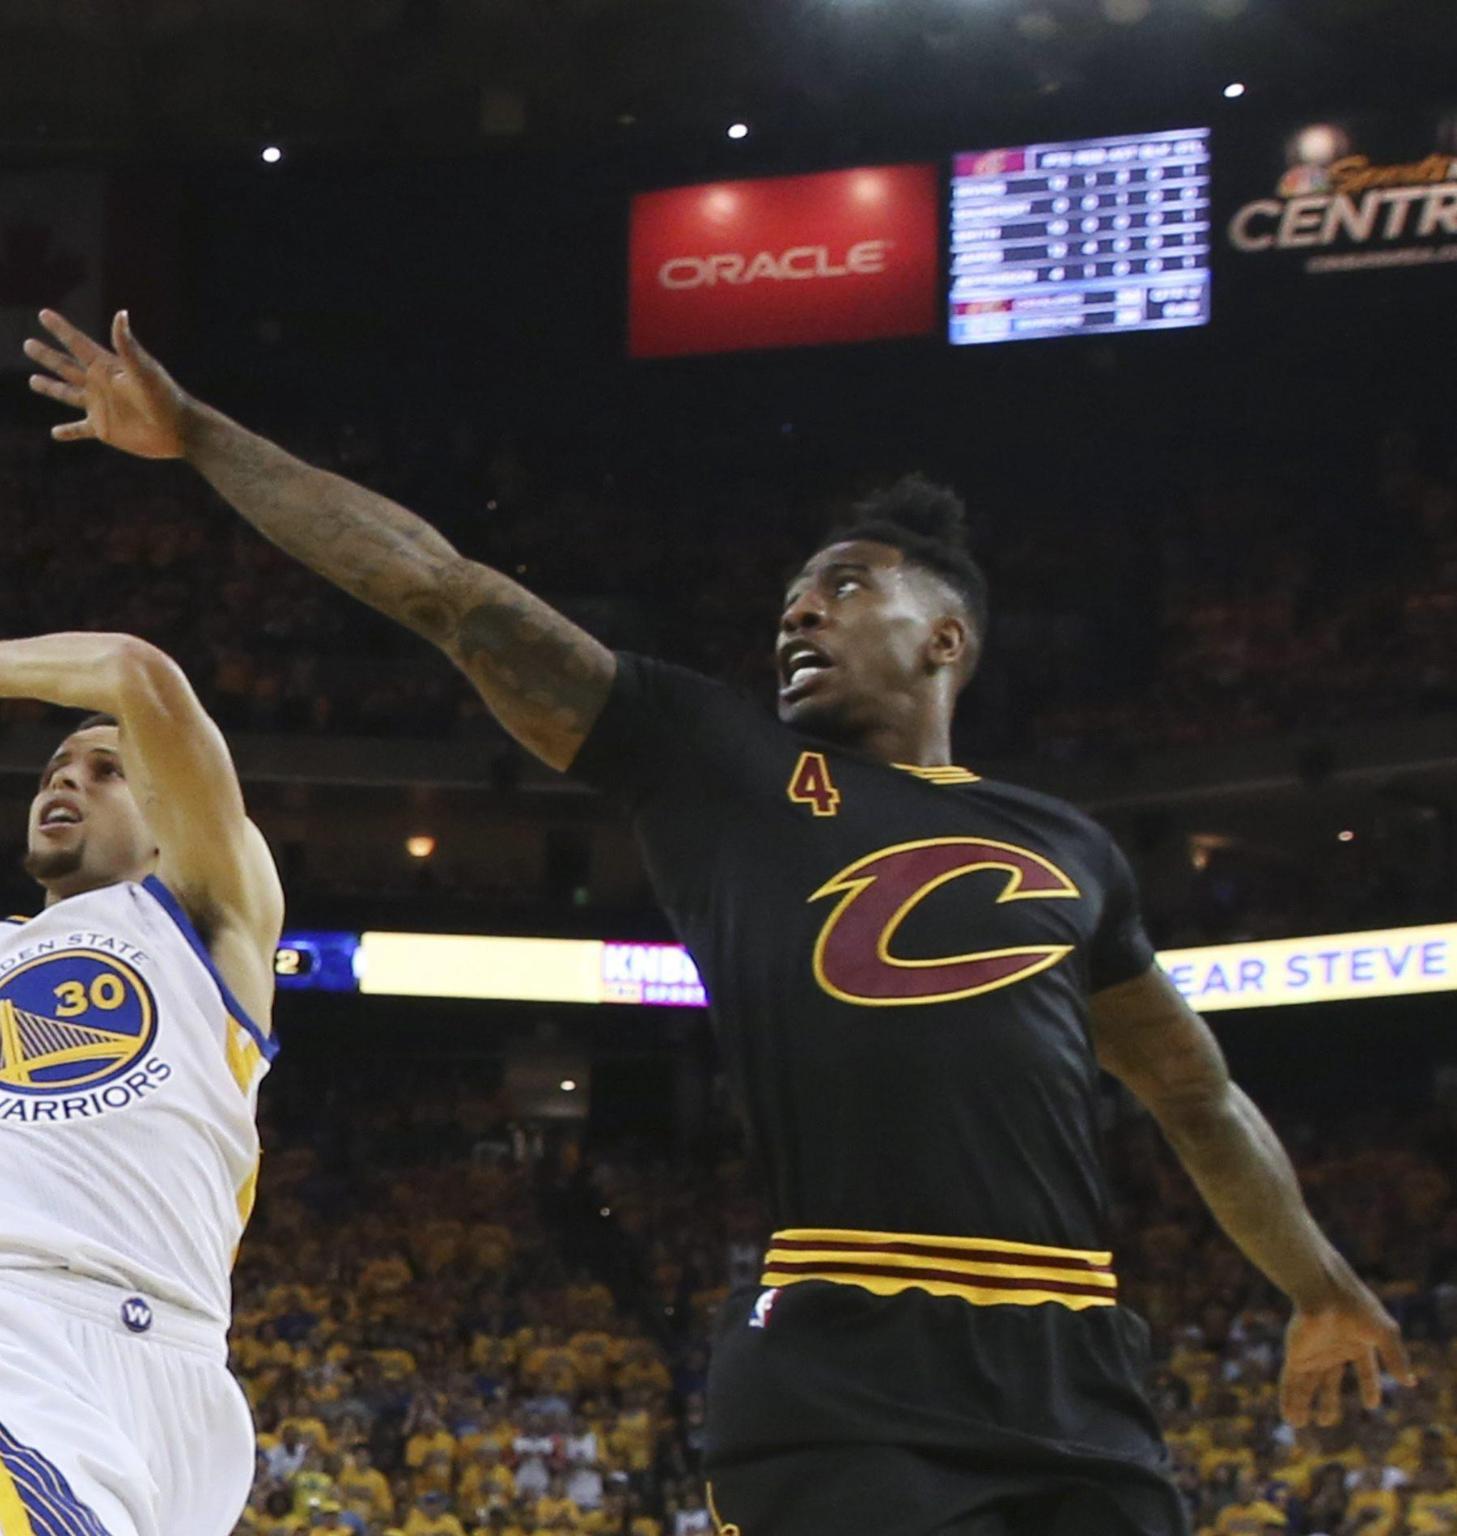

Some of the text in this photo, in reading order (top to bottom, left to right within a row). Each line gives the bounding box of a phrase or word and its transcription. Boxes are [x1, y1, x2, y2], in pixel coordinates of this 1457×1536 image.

[658, 244, 885, 289] ORACLE
[787, 751, 840, 816] 4
[67, 932, 152, 966] STATE
[1170, 941, 1449, 998] EAR STEVE
[53, 973, 126, 1018] 30
